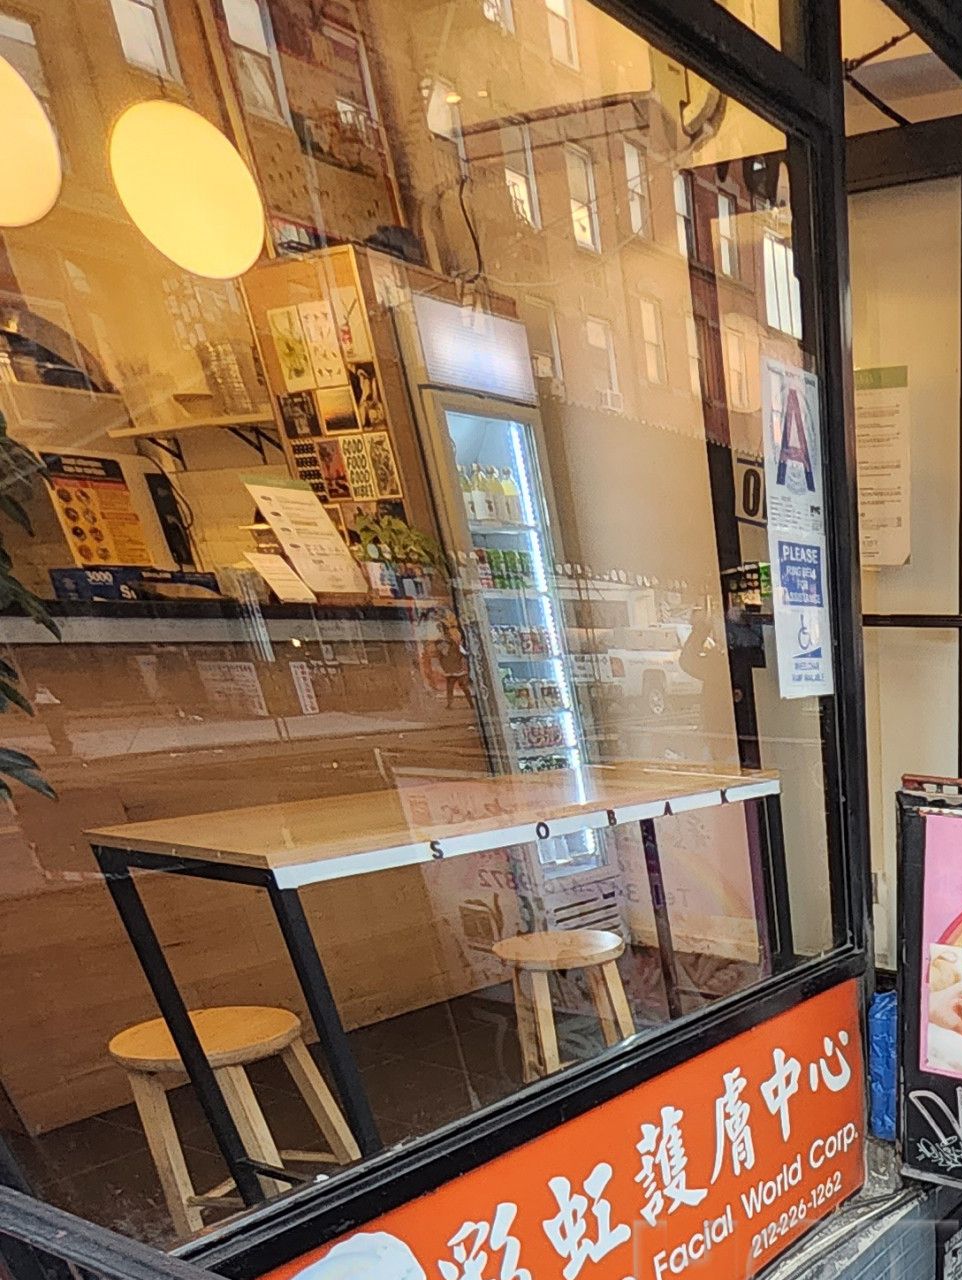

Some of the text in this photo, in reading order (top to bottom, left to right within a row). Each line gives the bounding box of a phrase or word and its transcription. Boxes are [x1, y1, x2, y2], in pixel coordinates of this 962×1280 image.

[776, 389, 815, 492] A
[782, 544, 819, 564] PLEASE
[741, 1154, 802, 1220] World
[808, 1122, 860, 1171] Corp.
[750, 1170, 843, 1260] 212-226-1262
